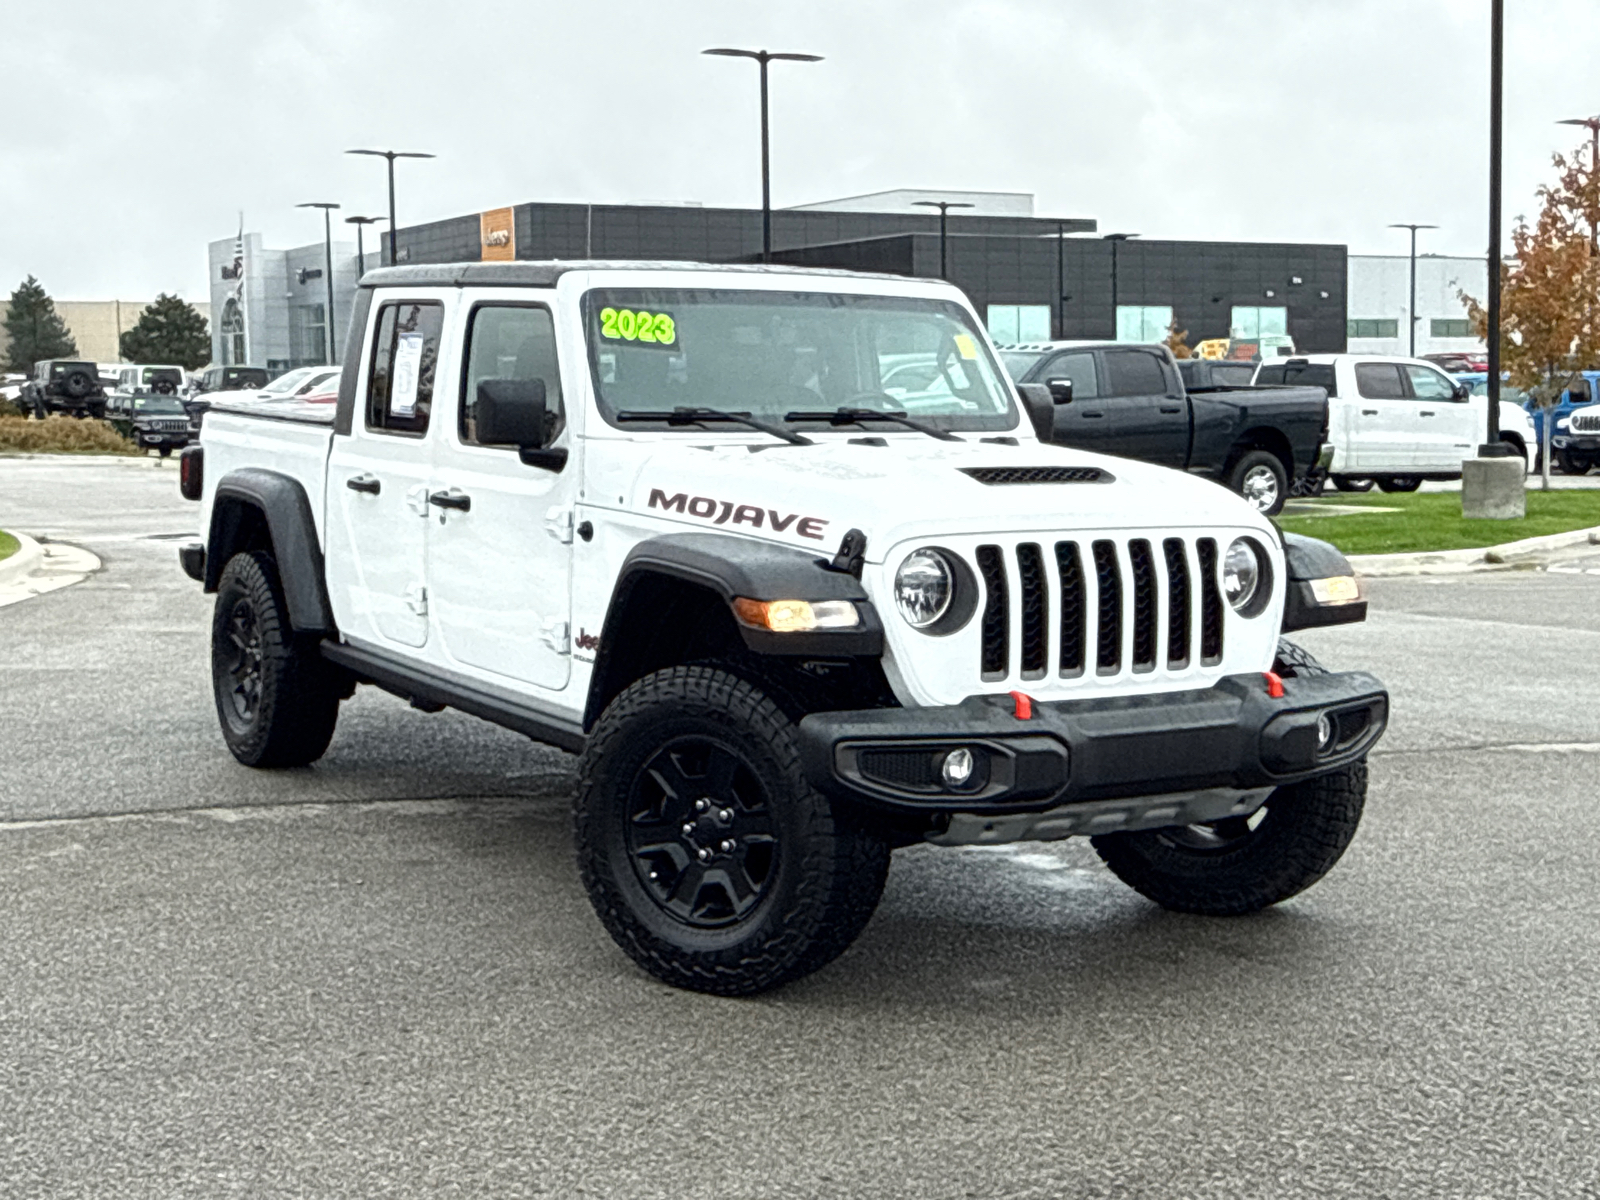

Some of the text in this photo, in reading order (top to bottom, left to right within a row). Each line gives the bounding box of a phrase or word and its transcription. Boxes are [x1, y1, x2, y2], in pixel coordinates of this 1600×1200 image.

[600, 307, 676, 345] 2023
[647, 488, 830, 540] MOJAVE
[574, 627, 600, 651] Jee
